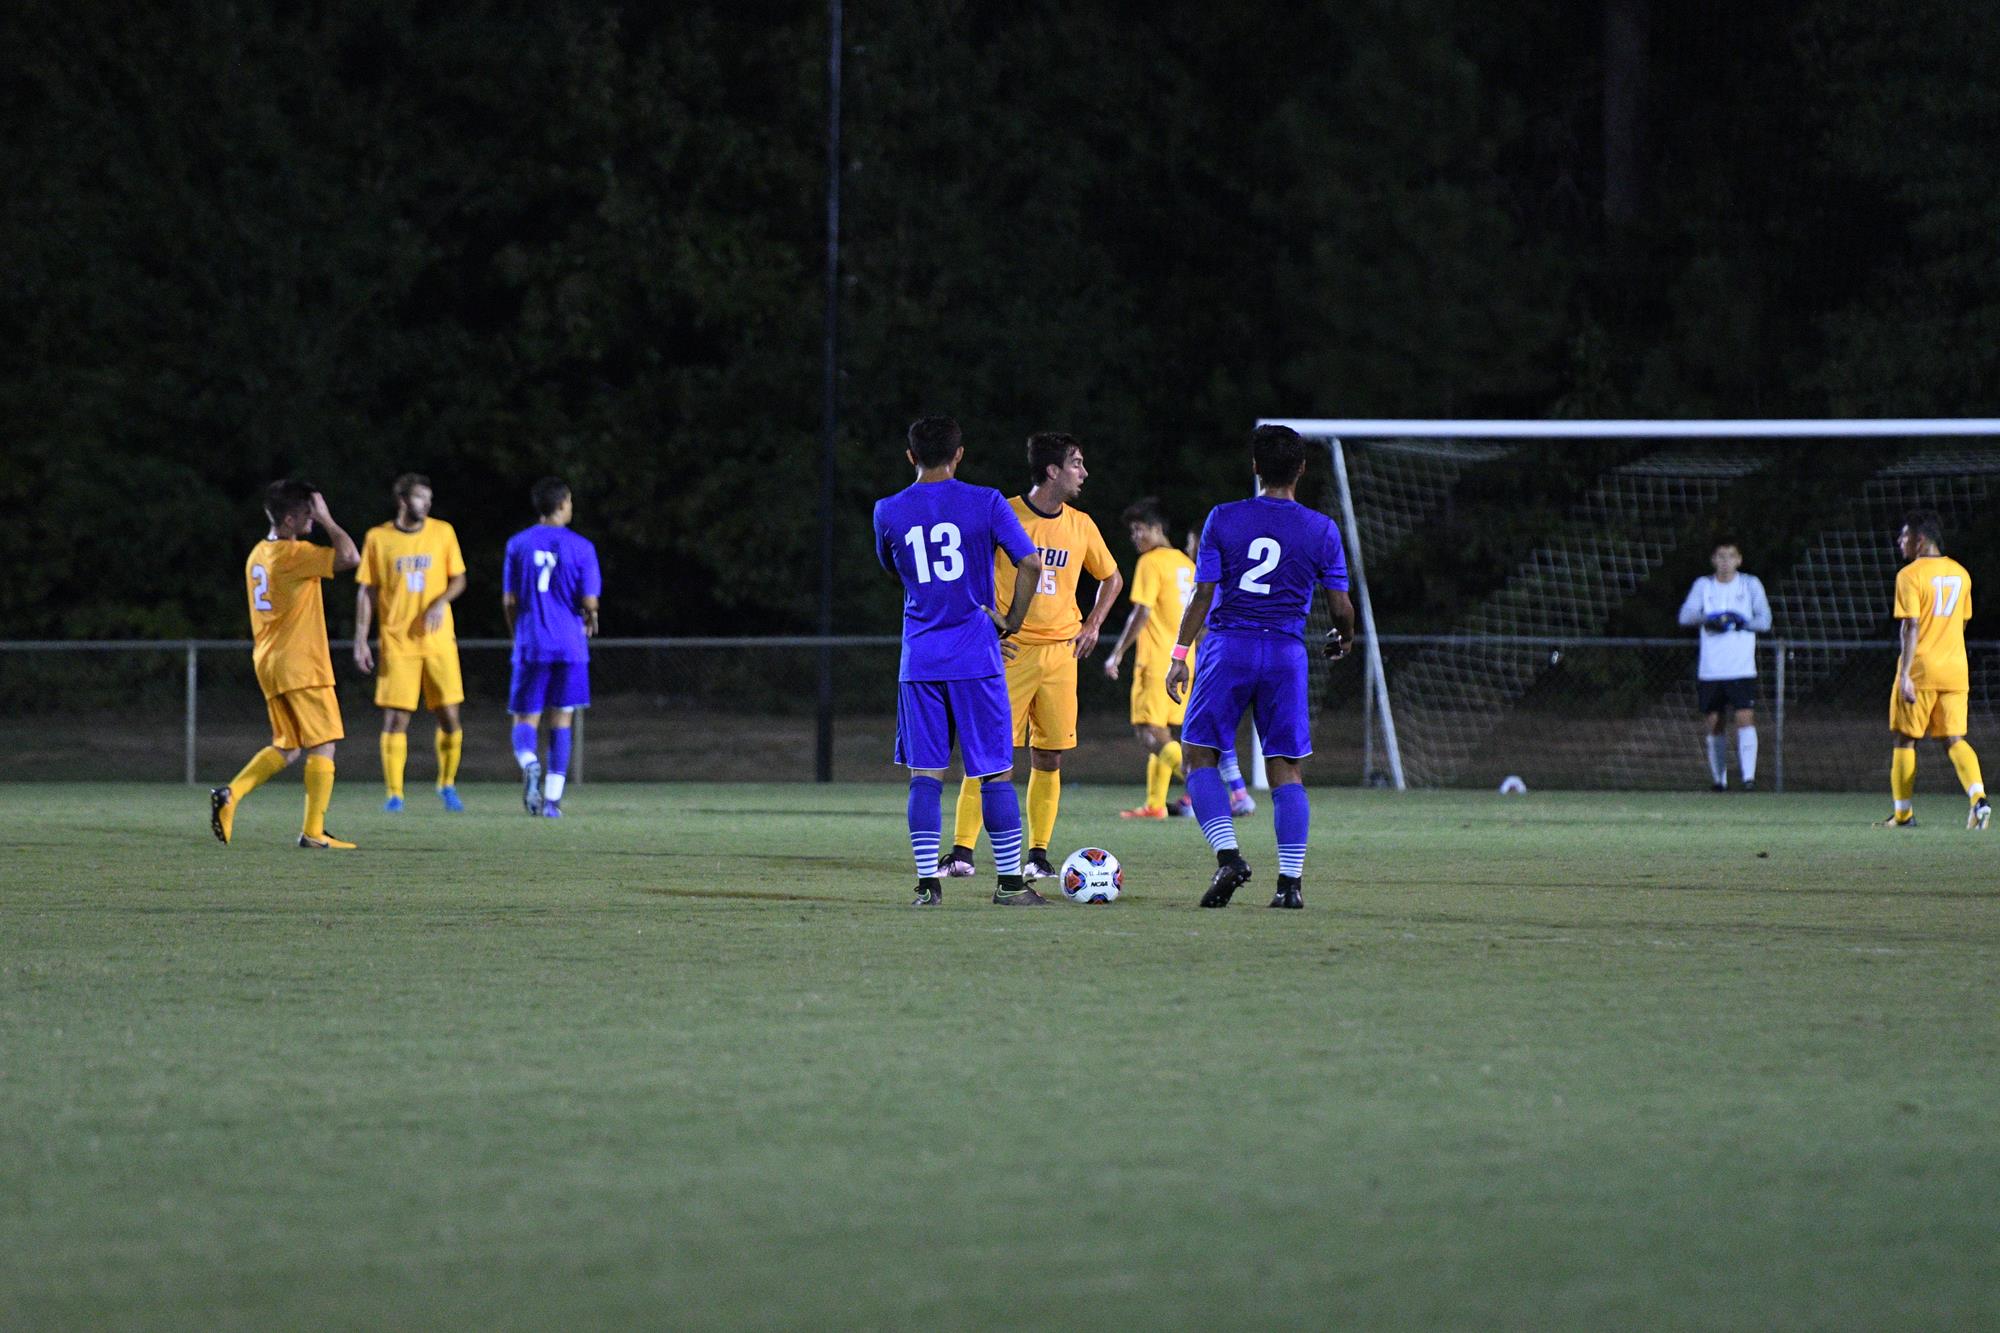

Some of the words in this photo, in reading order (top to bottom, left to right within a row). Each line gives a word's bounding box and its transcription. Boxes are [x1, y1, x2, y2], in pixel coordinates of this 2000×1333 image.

[533, 549, 558, 593] 7
[904, 522, 965, 584] 13
[1238, 537, 1282, 595] 2
[252, 563, 273, 611] 2
[1931, 575, 1963, 617] 17
